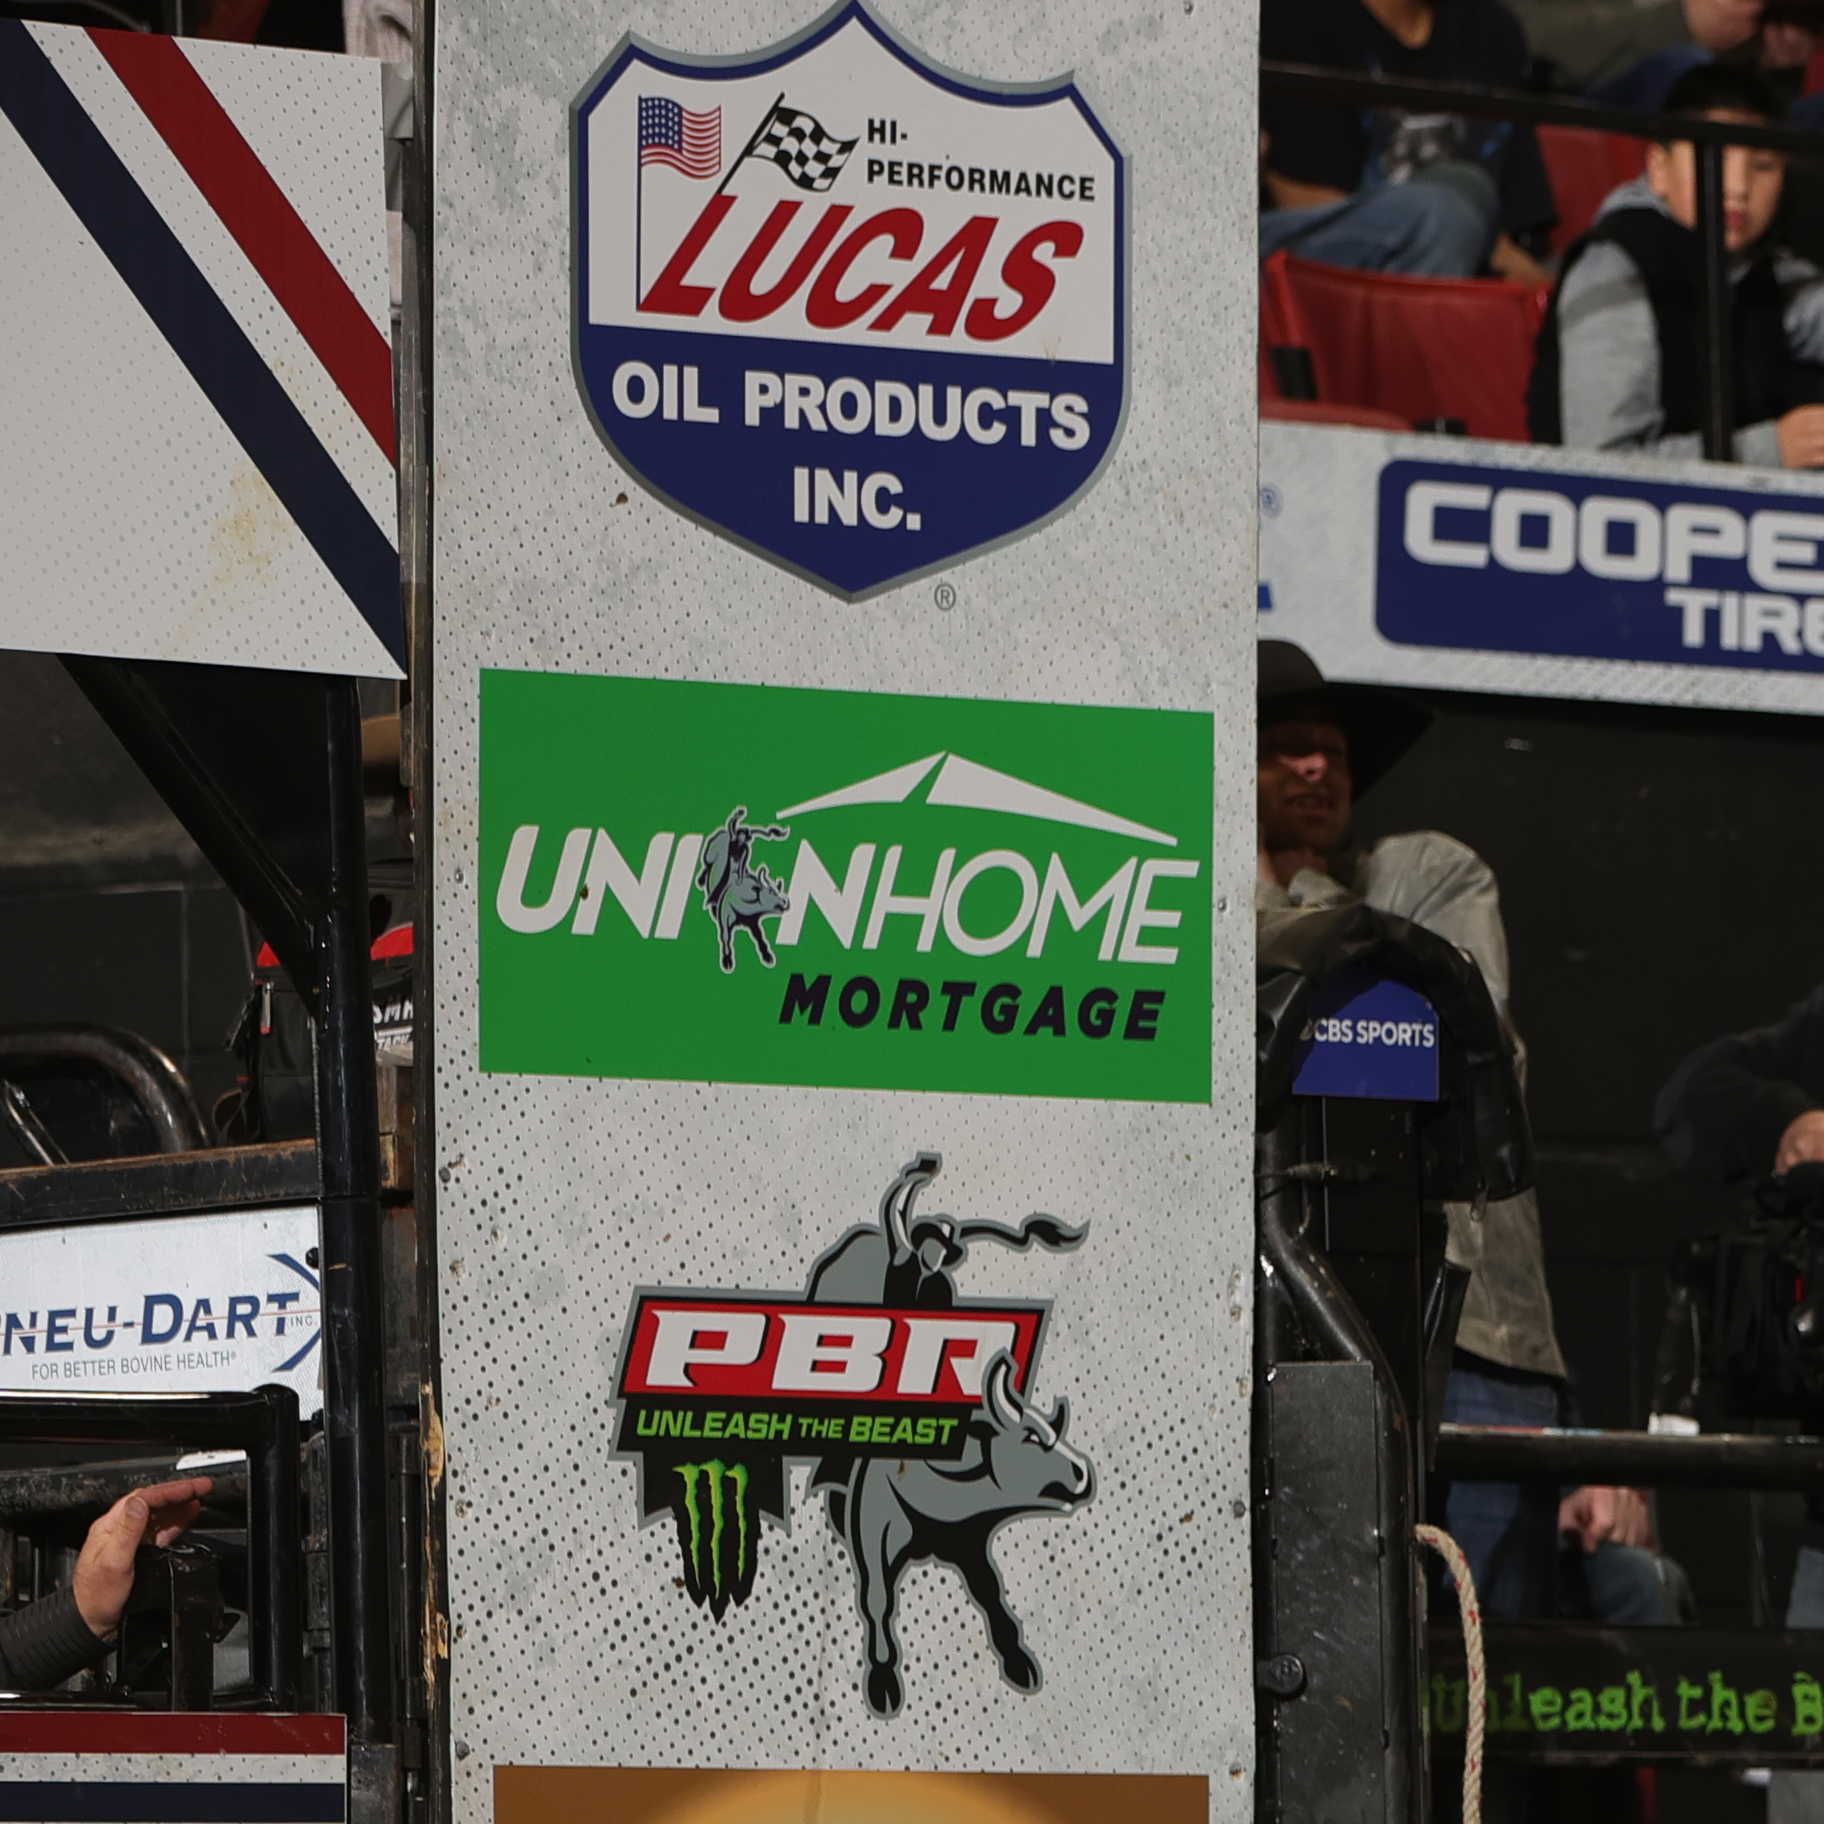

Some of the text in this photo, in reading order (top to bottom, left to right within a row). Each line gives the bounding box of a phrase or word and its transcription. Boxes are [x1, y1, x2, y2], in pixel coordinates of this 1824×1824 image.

[866, 116, 910, 147] HI-
[866, 160, 1097, 201] PERFORMANCE
[637, 193, 1085, 342] LUCAS
[611, 360, 1091, 450] OIL PRODUCTS
[792, 466, 922, 531] INC.
[778, 973, 1167, 1041] MORTGAGE
[1314, 1018, 1436, 1048] CBS SPORTS
[0, 1292, 300, 1356] NEU-DART
[646, 1310, 1016, 1396] PBR
[32, 1352, 231, 1381] FOR BETTER BOVINE HEALTH
[636, 1409, 959, 1446] UNLEASH THE BEAST
[1676, 1669, 1777, 1736] the
